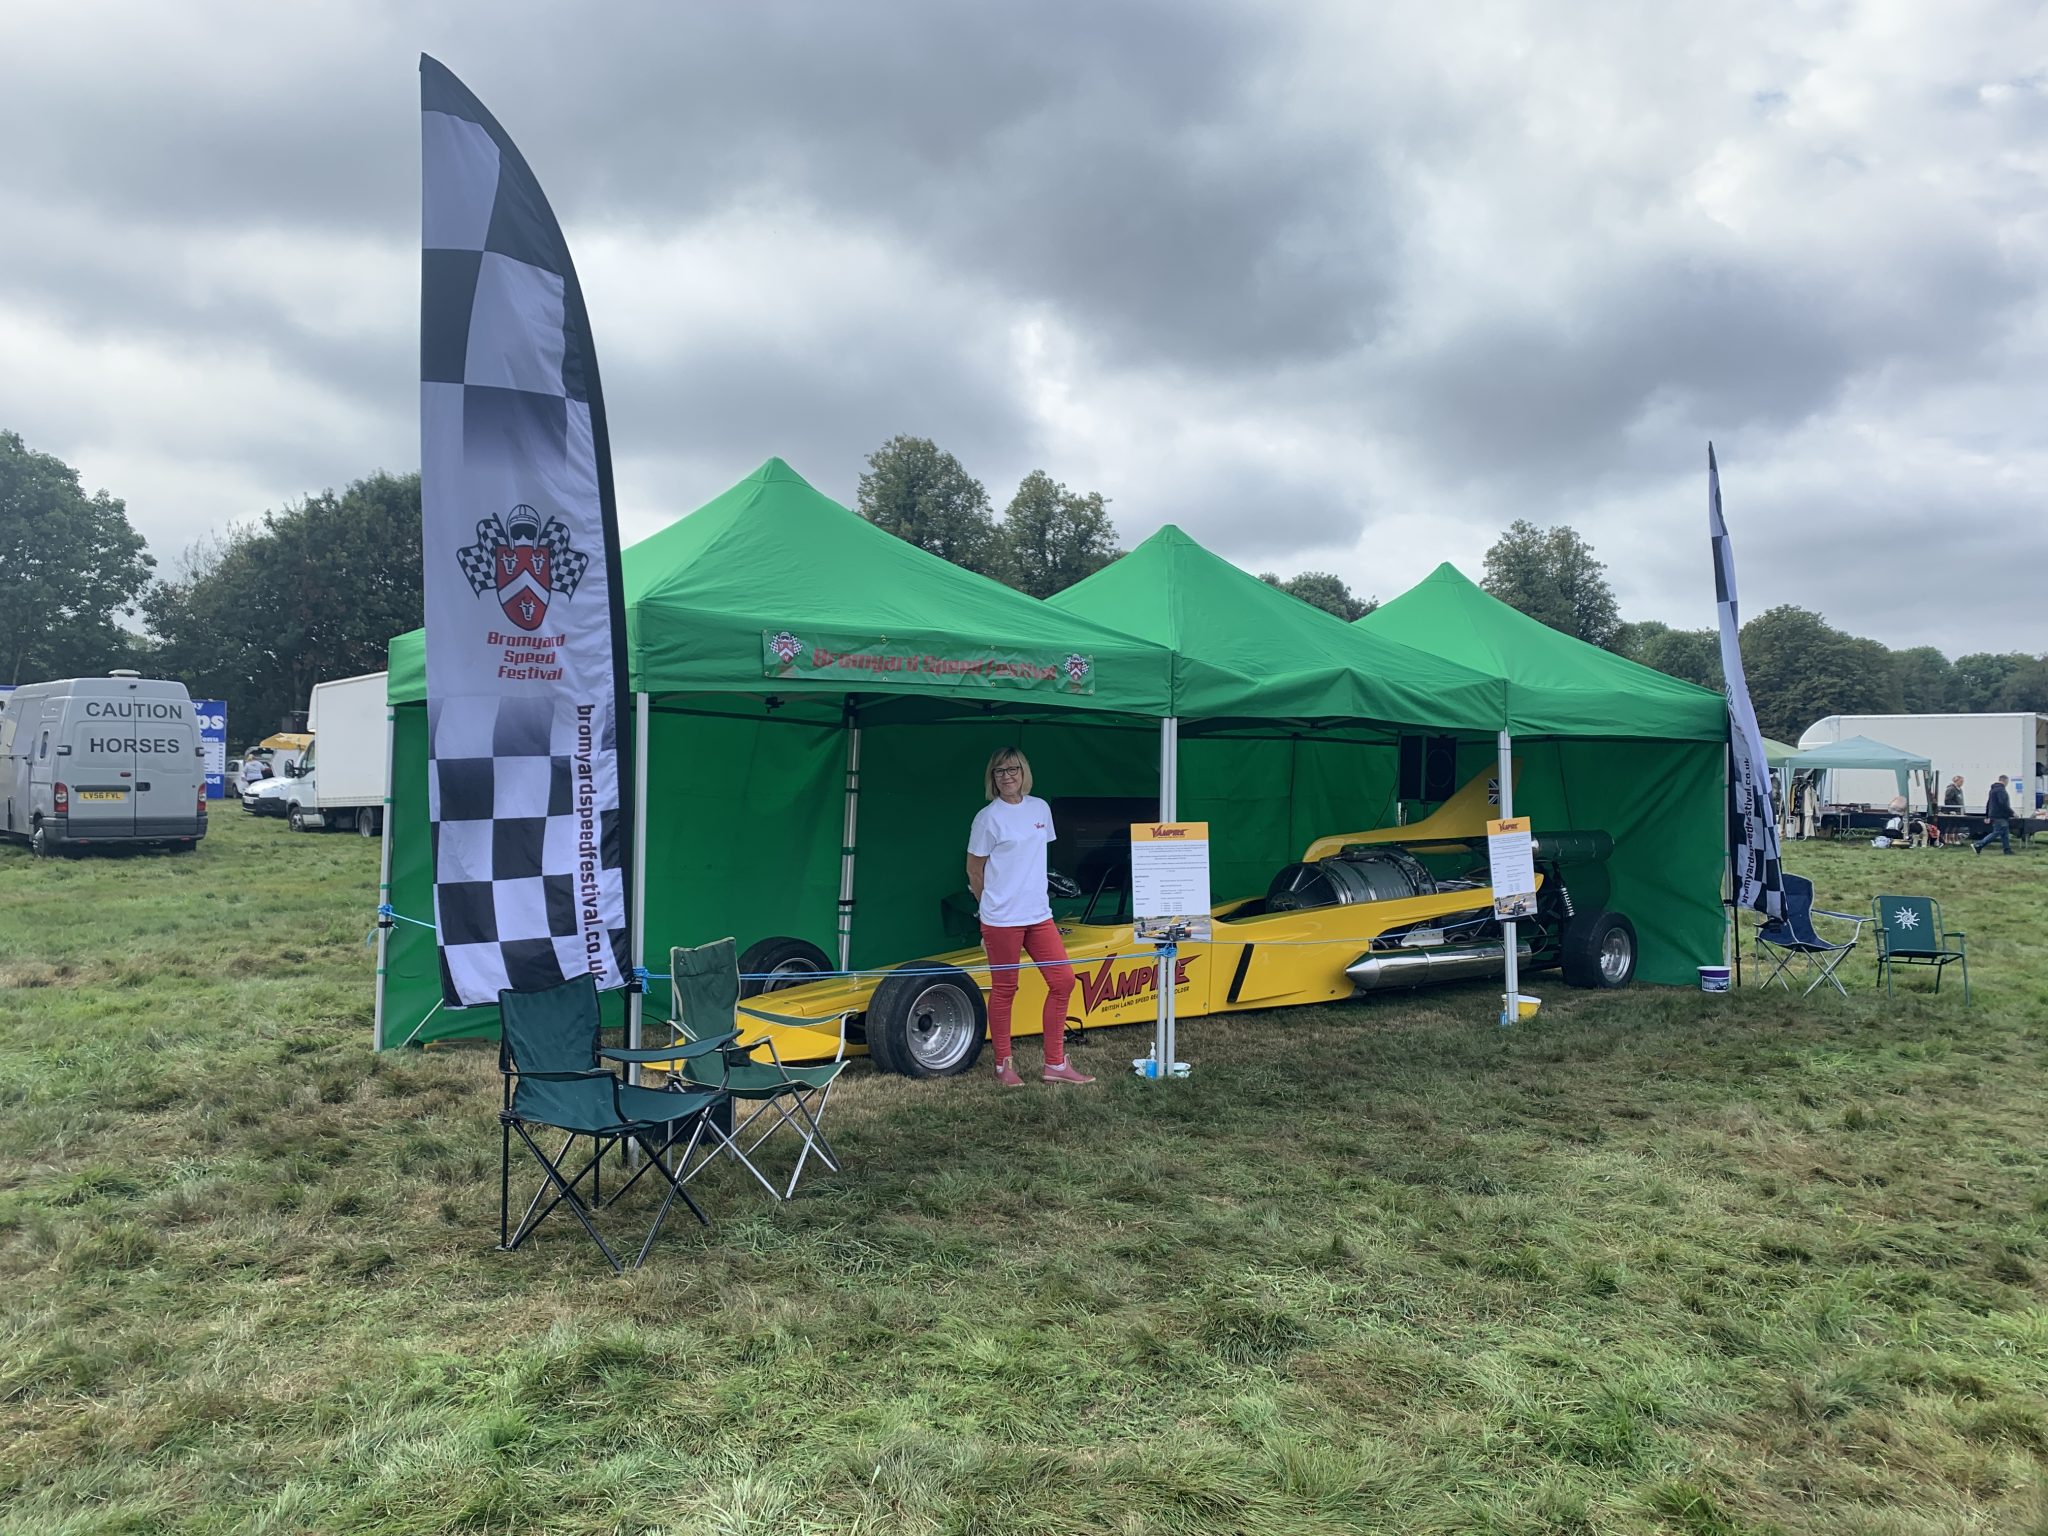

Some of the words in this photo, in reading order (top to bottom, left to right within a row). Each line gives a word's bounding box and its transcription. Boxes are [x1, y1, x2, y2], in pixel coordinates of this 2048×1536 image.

[487, 631, 566, 650] Bromyard
[503, 650, 556, 666] Speed
[497, 665, 563, 681] Festival
[86, 702, 183, 719] CAUTION
[90, 738, 180, 754] HORSES
[576, 704, 607, 983] bromyardspeedfestival.co.uk
[1075, 952, 1202, 1017] VAMPIE
[1120, 1000, 1135, 1008] LAND
[1135, 995, 1150, 1004] SPEED
